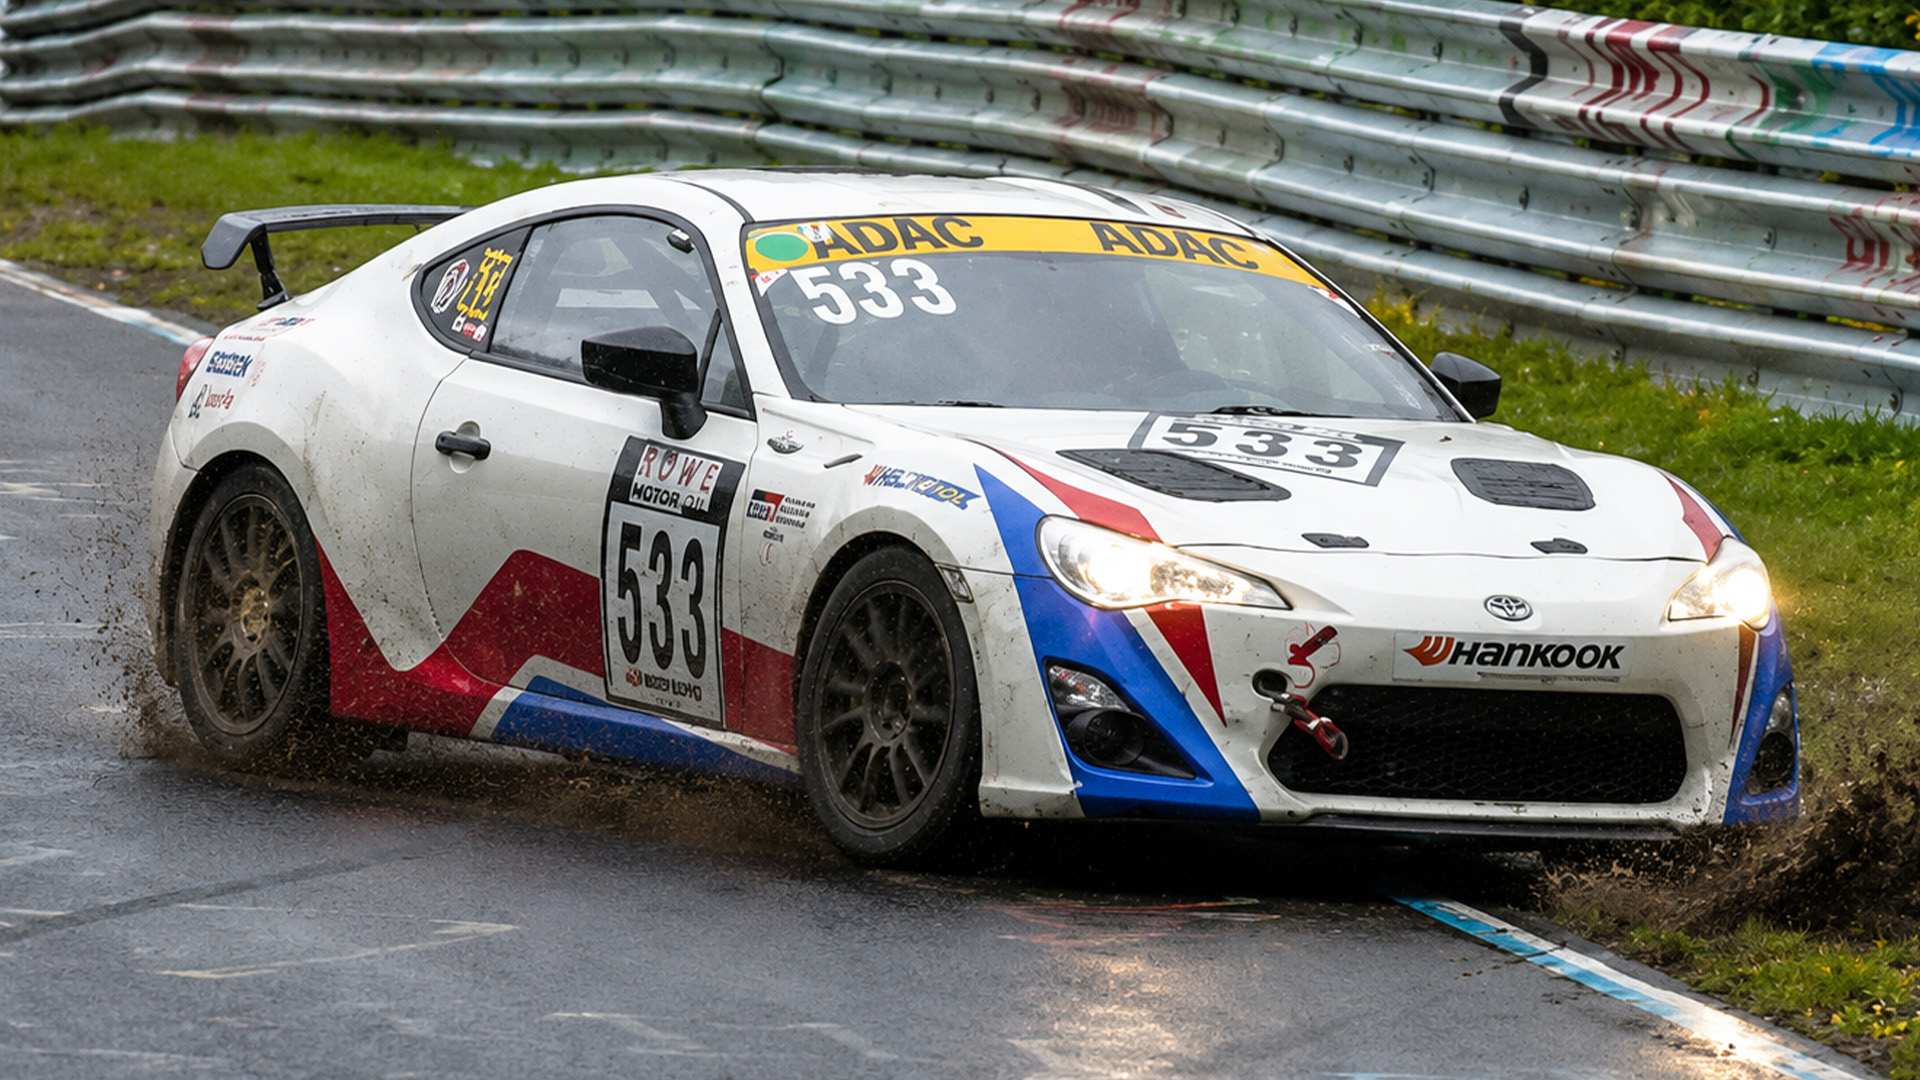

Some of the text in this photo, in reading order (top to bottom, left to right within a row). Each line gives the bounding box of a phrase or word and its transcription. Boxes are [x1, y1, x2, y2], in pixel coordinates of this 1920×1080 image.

[814, 216, 1259, 270] ADAC ADAC
[789, 258, 958, 325] 533
[637, 446, 720, 492] ROWE
[1162, 422, 1363, 468] 533
[617, 521, 707, 679] 533
